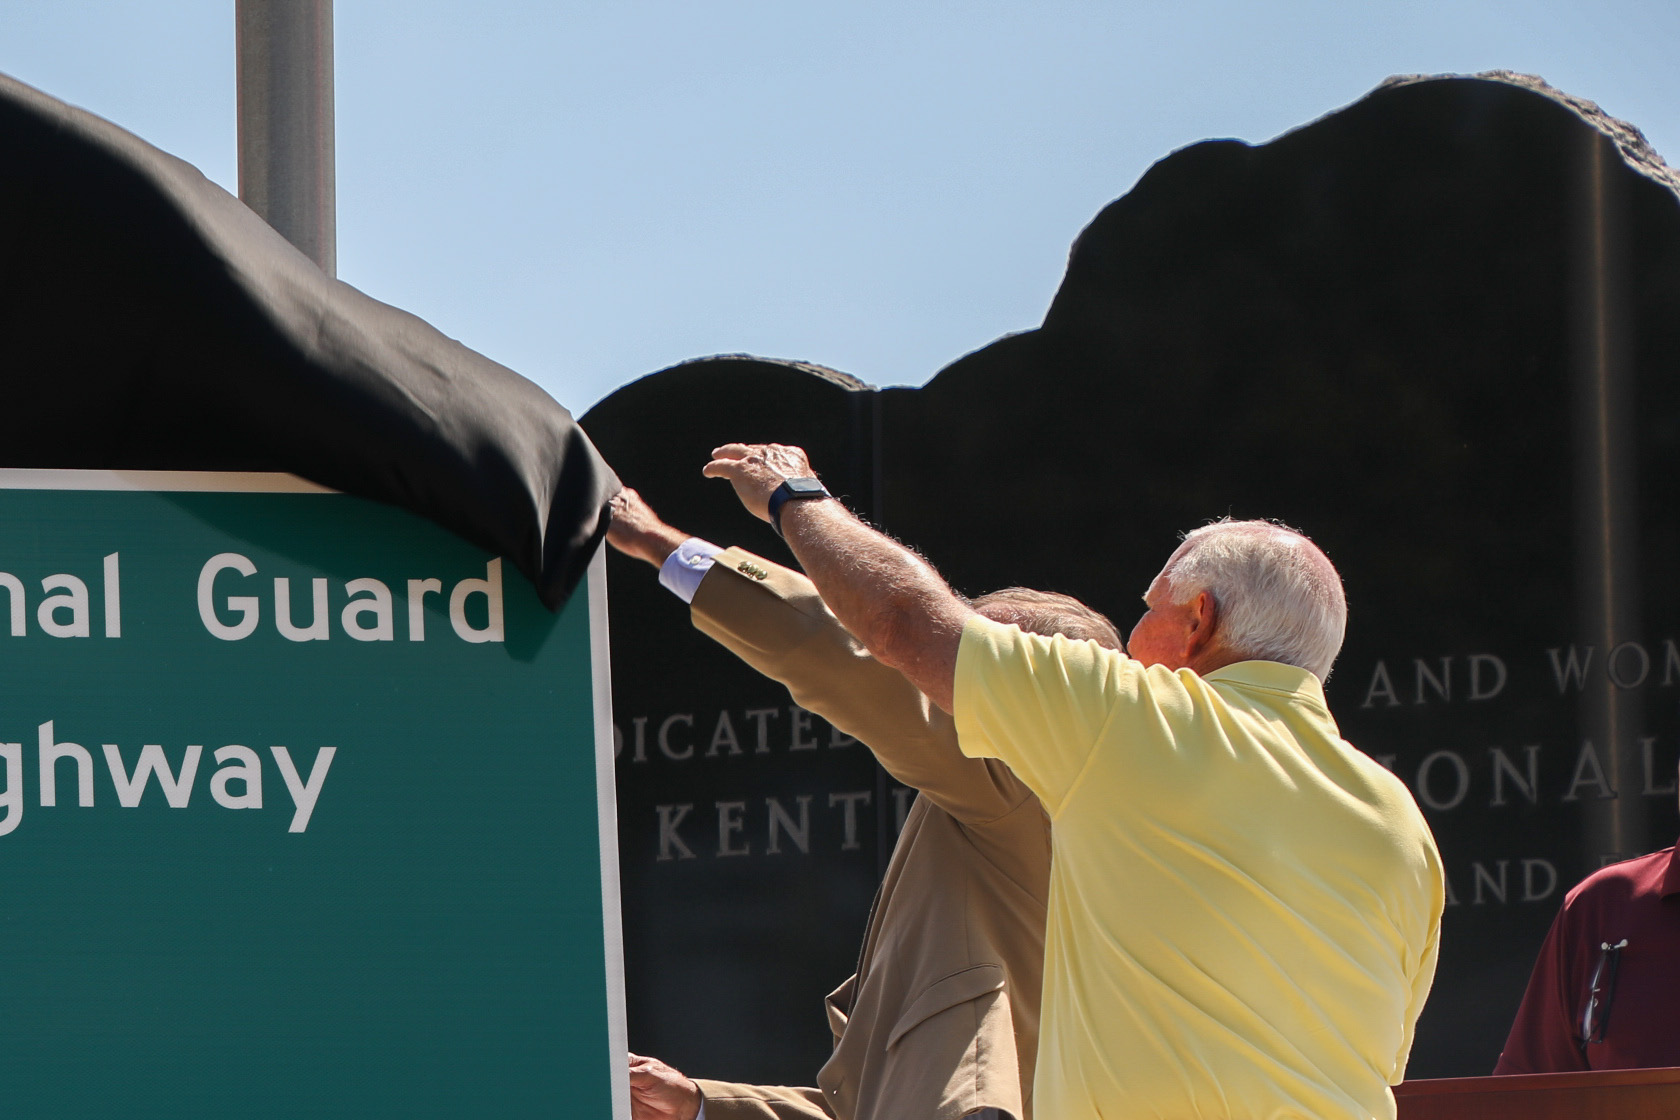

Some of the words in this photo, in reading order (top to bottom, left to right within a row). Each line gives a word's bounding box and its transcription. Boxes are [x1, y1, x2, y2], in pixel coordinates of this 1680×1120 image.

[197, 552, 505, 644] Guard
[614, 705, 858, 763] ICATE
[1361, 654, 1507, 709] AND
[1380, 737, 1677, 811] ONAL
